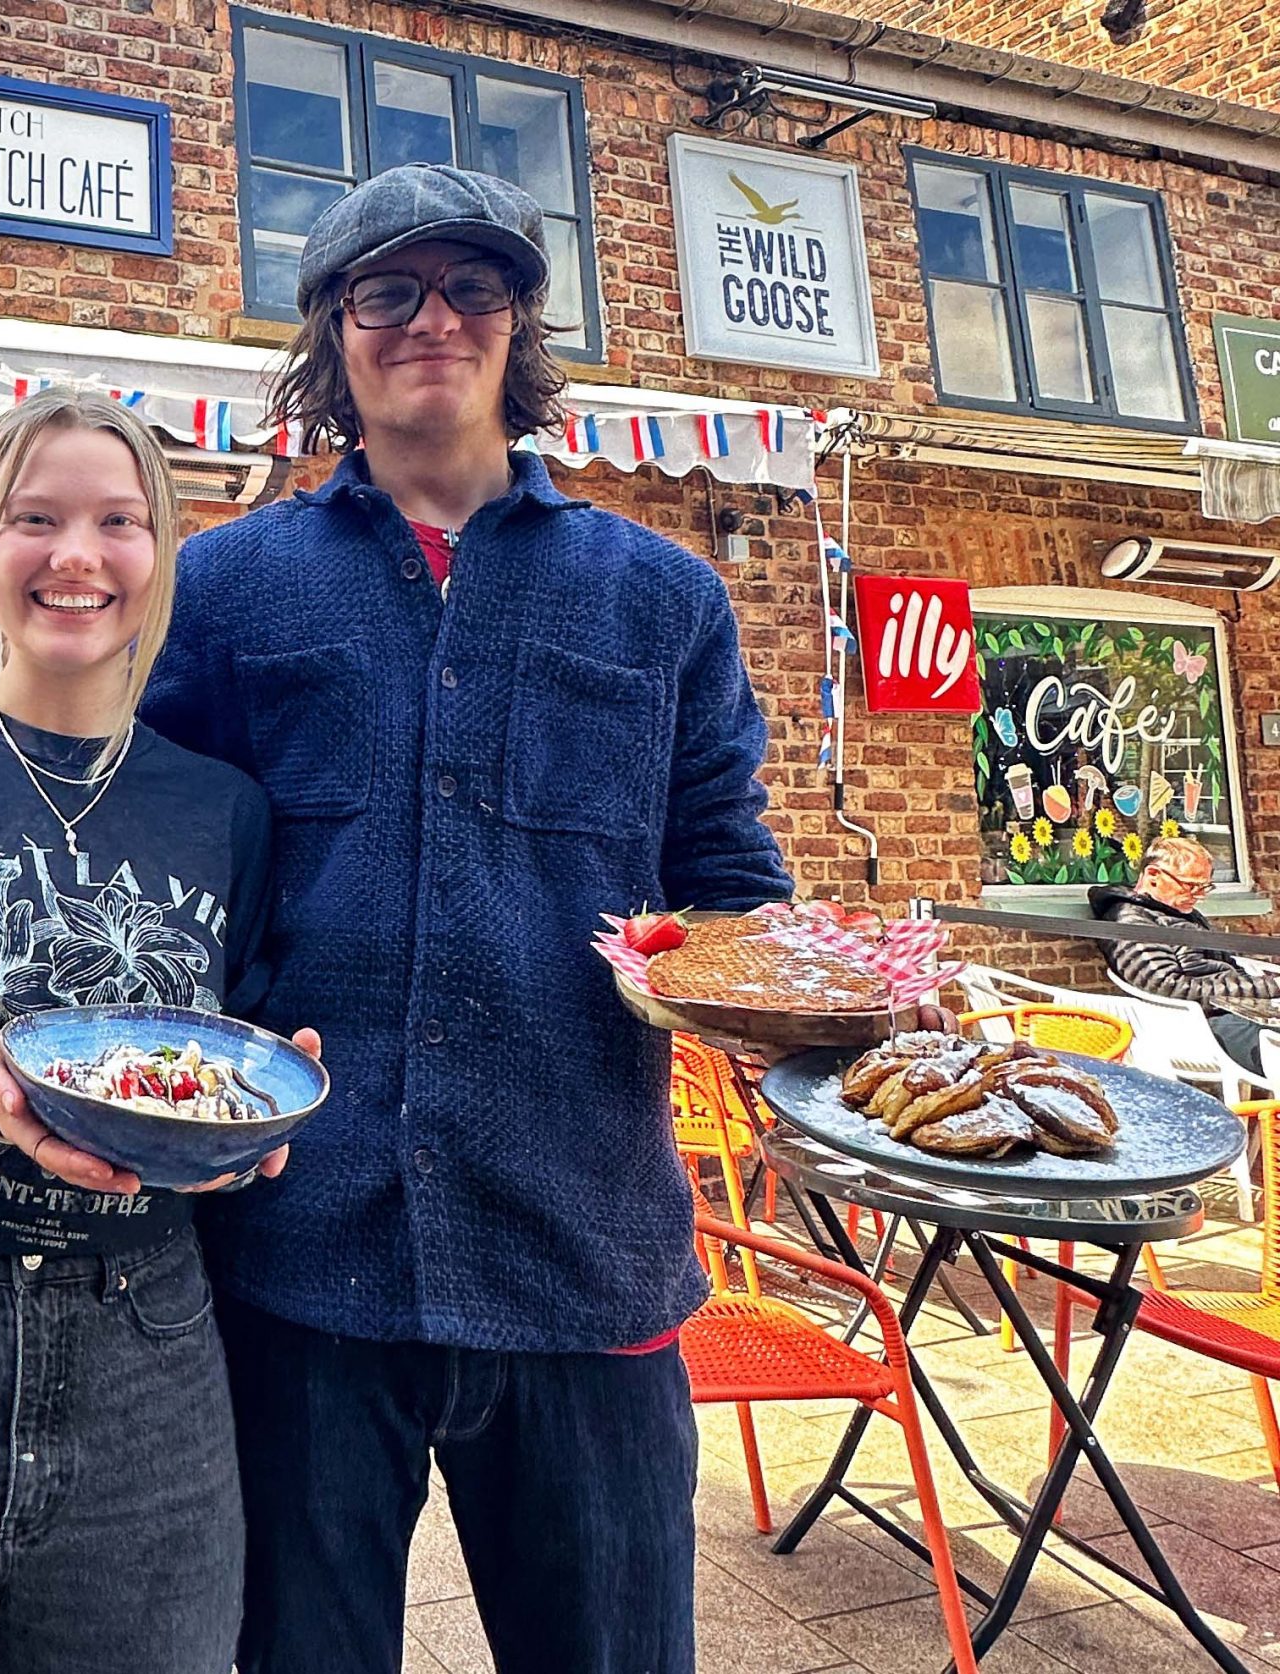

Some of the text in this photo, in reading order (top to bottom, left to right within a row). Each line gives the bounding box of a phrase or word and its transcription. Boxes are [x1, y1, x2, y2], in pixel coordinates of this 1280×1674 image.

[59, 159, 134, 222] CAFÉ
[716, 223, 743, 267] THE
[743, 227, 826, 282] WILD
[723, 274, 834, 336] GOOSE
[879, 590, 971, 699] illy
[1025, 675, 1176, 774] Café
[75, 852, 142, 895] LA
